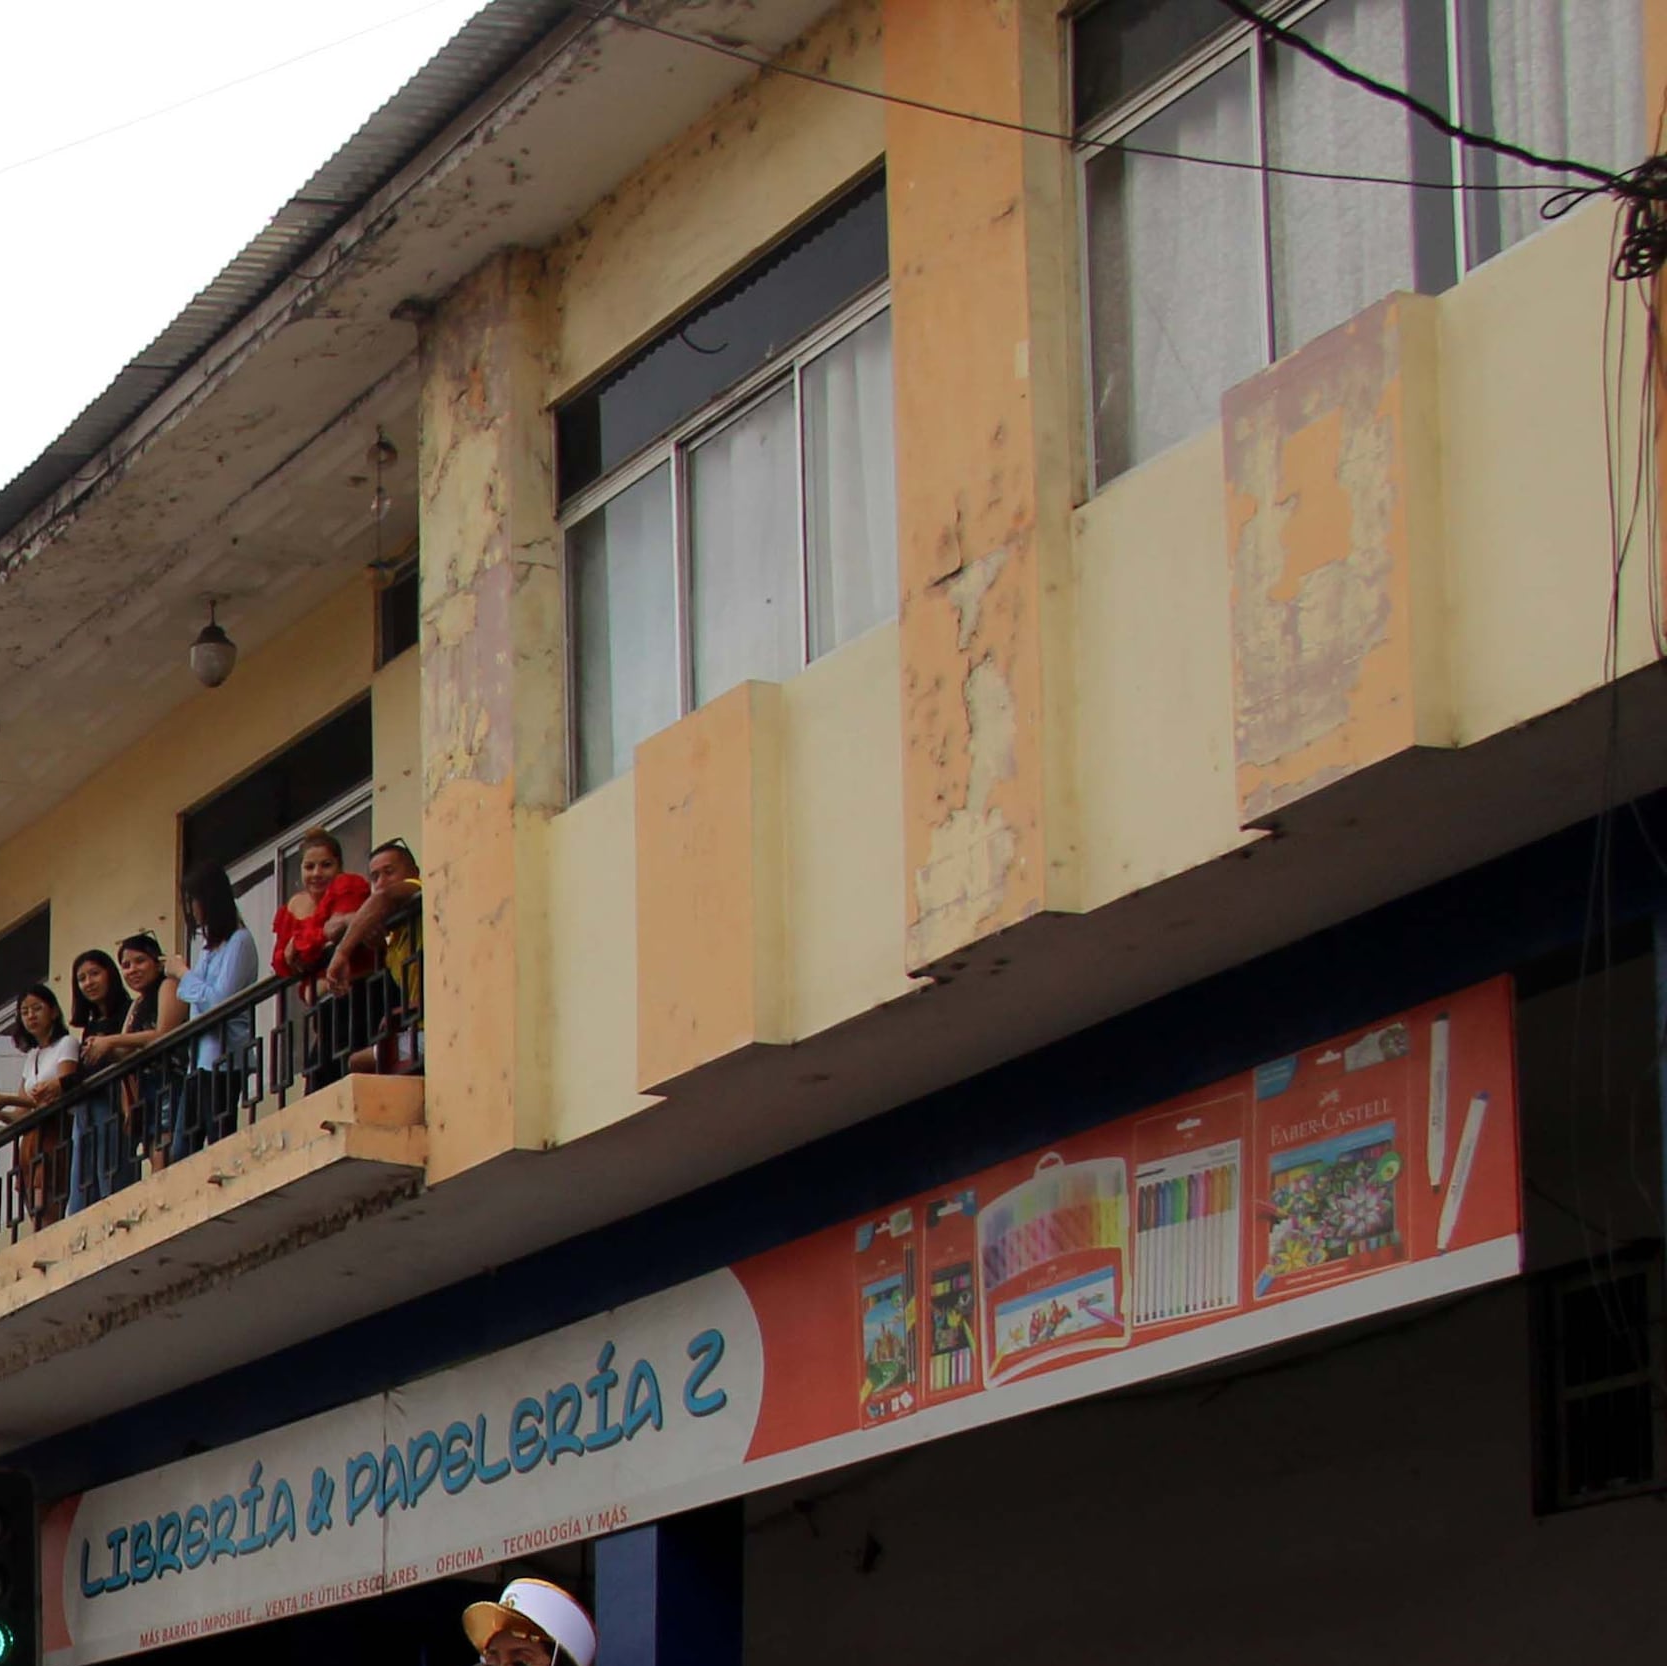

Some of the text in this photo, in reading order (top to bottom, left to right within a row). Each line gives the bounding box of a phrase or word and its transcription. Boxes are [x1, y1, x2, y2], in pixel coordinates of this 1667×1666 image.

[1269, 1098, 1392, 1147] FABER-CASTELL
[80, 1329, 727, 1598] LIBRERÍA & PAPELERÍA 2
[162, 1620, 199, 1643] BARATO
[265, 1596, 299, 1617] VENTA
[301, 1592, 315, 1609] DE
[356, 1565, 419, 1595] ESCOLARES
[436, 1546, 484, 1575] OFICINA
[503, 1518, 581, 1556] TECNOLOGÍA
[586, 1513, 594, 1531] Y
[598, 1504, 628, 1531] MÁS
